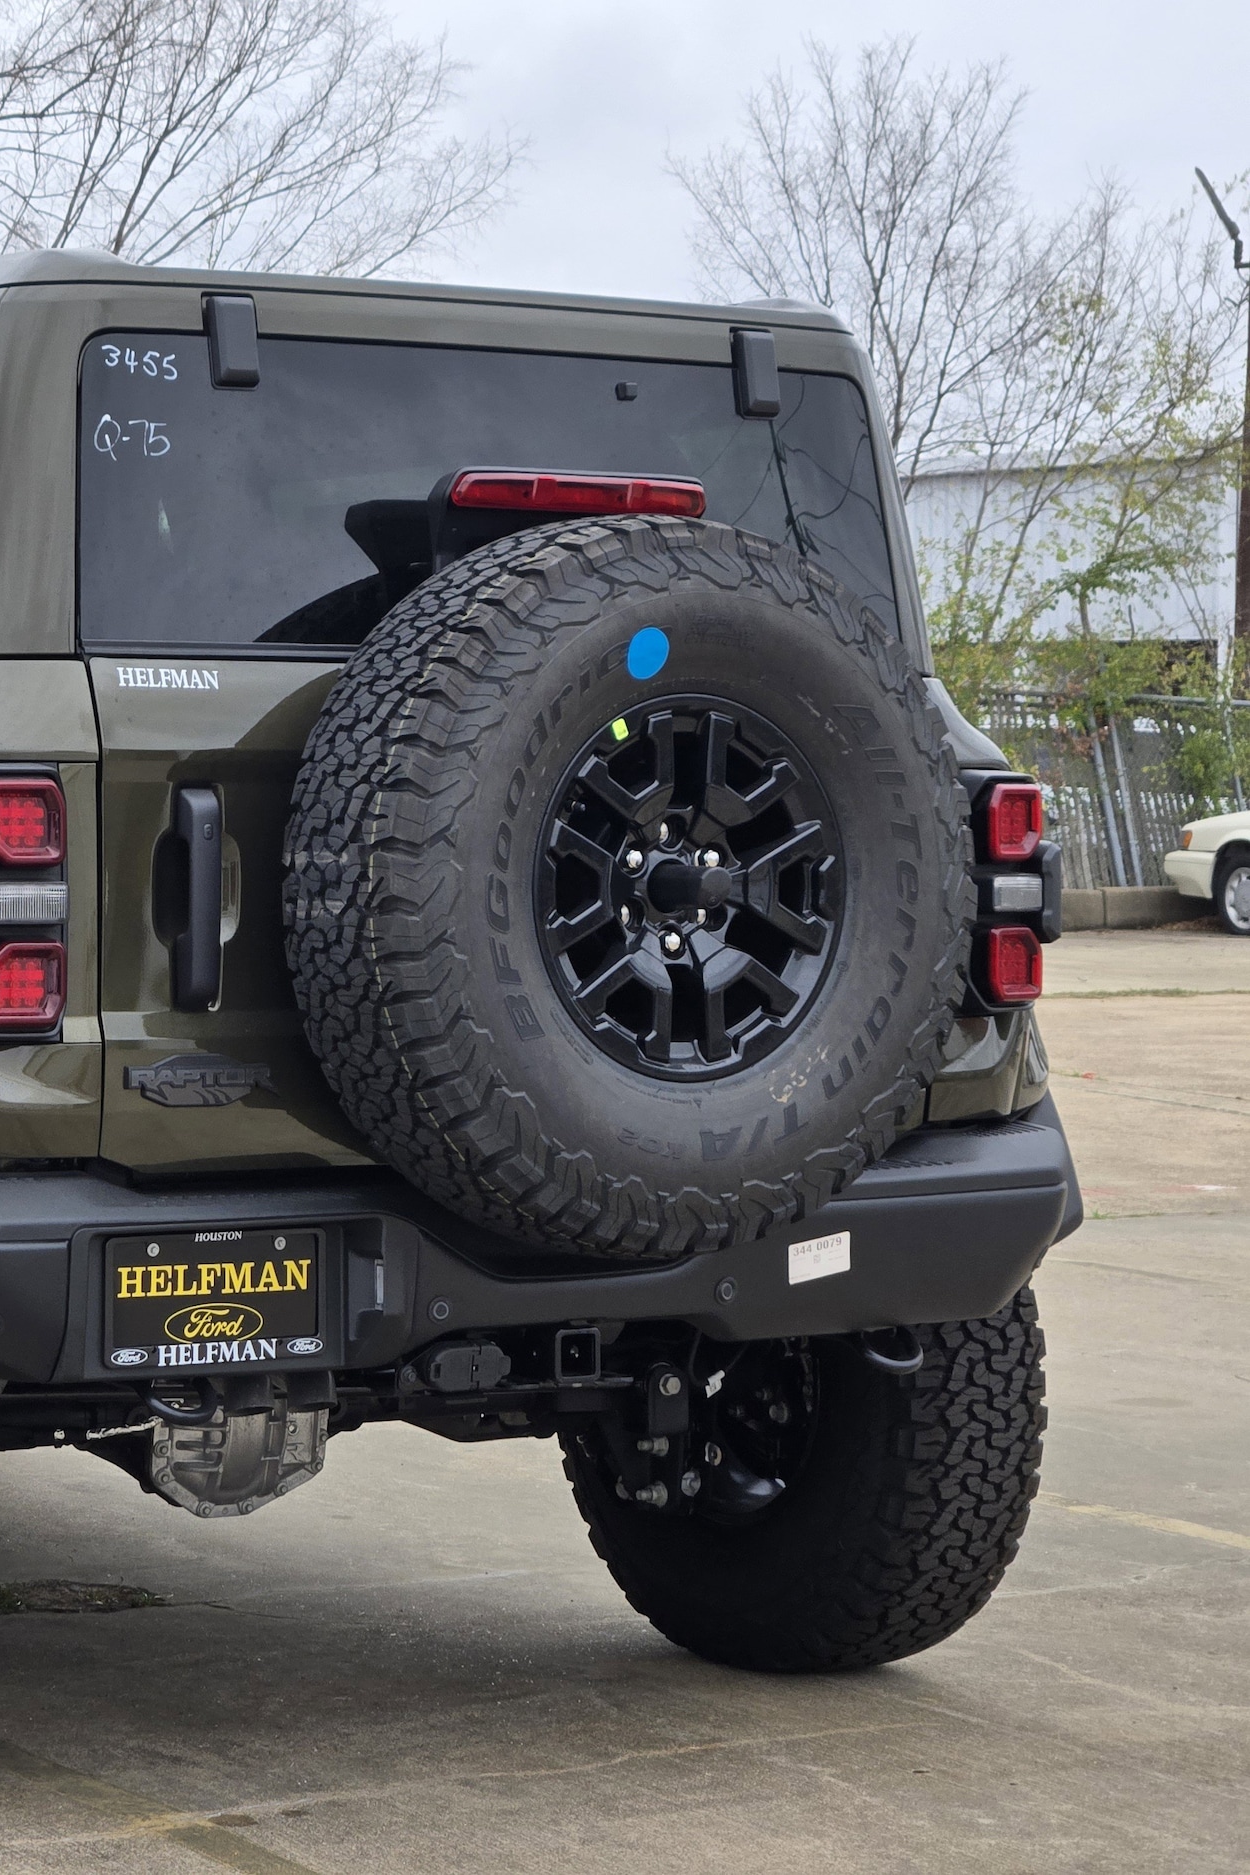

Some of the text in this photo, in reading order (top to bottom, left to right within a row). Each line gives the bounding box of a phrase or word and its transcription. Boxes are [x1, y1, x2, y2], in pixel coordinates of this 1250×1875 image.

[101, 344, 178, 381] 3455
[93, 414, 171, 462] Q-75
[116, 666, 220, 690] HELFMAN
[487, 625, 672, 1041] BFGoodric
[131, 1066, 278, 1100] RAPTOR
[194, 1230, 243, 1243] HOUSTON
[793, 1245, 812, 1257] 344
[816, 1236, 842, 1251] 0079
[117, 1259, 311, 1298] HELFMAN
[183, 1308, 244, 1338] Ford
[157, 1338, 278, 1367] HELFMAN
